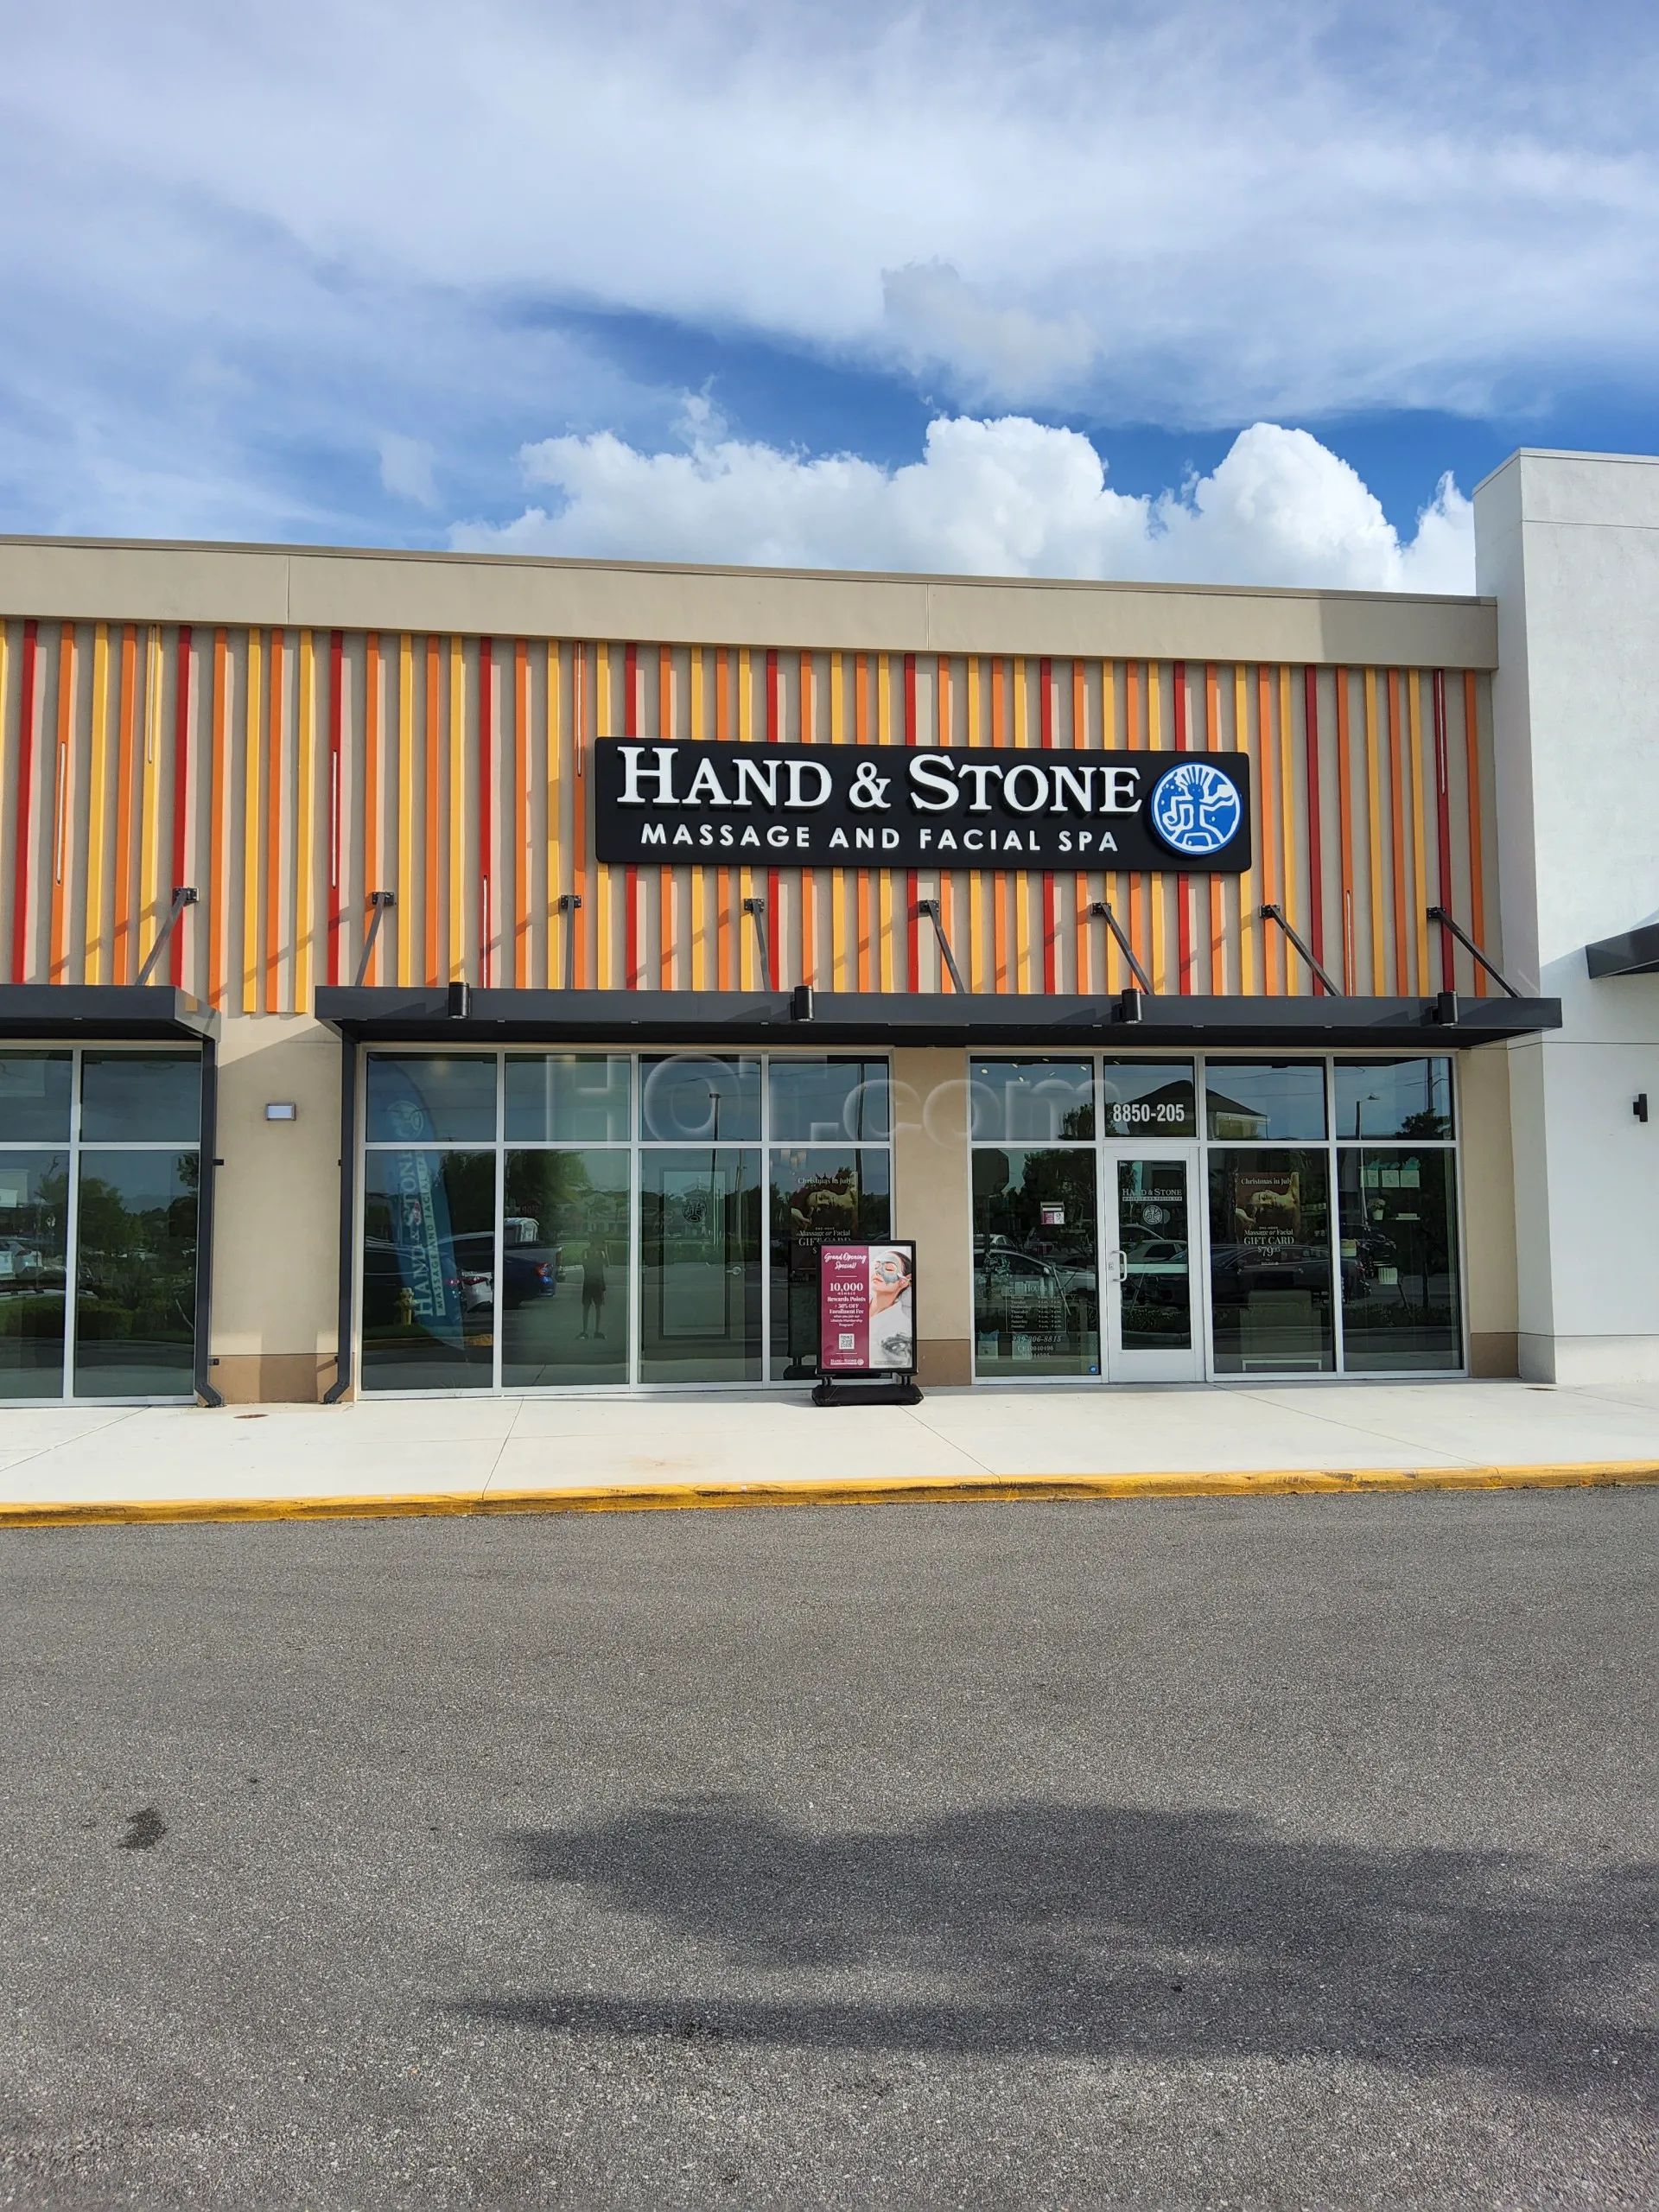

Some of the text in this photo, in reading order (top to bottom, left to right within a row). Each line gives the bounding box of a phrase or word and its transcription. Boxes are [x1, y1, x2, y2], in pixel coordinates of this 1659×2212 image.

[617, 746, 1142, 812] HAND & STONE
[641, 823, 1118, 852] MASSAGE AND FACIAL SPA
[1113, 1103, 1185, 1122] 8850-205
[1243, 1236, 1294, 1245] GIFT CARD
[823, 1252, 867, 1264] Grand Opening
[835, 1261, 857, 1270] Special!
[412, 1245, 434, 1317] HAND
[431, 1253, 444, 1310] MASSAGE
[830, 1282, 863, 1293] 10,000
